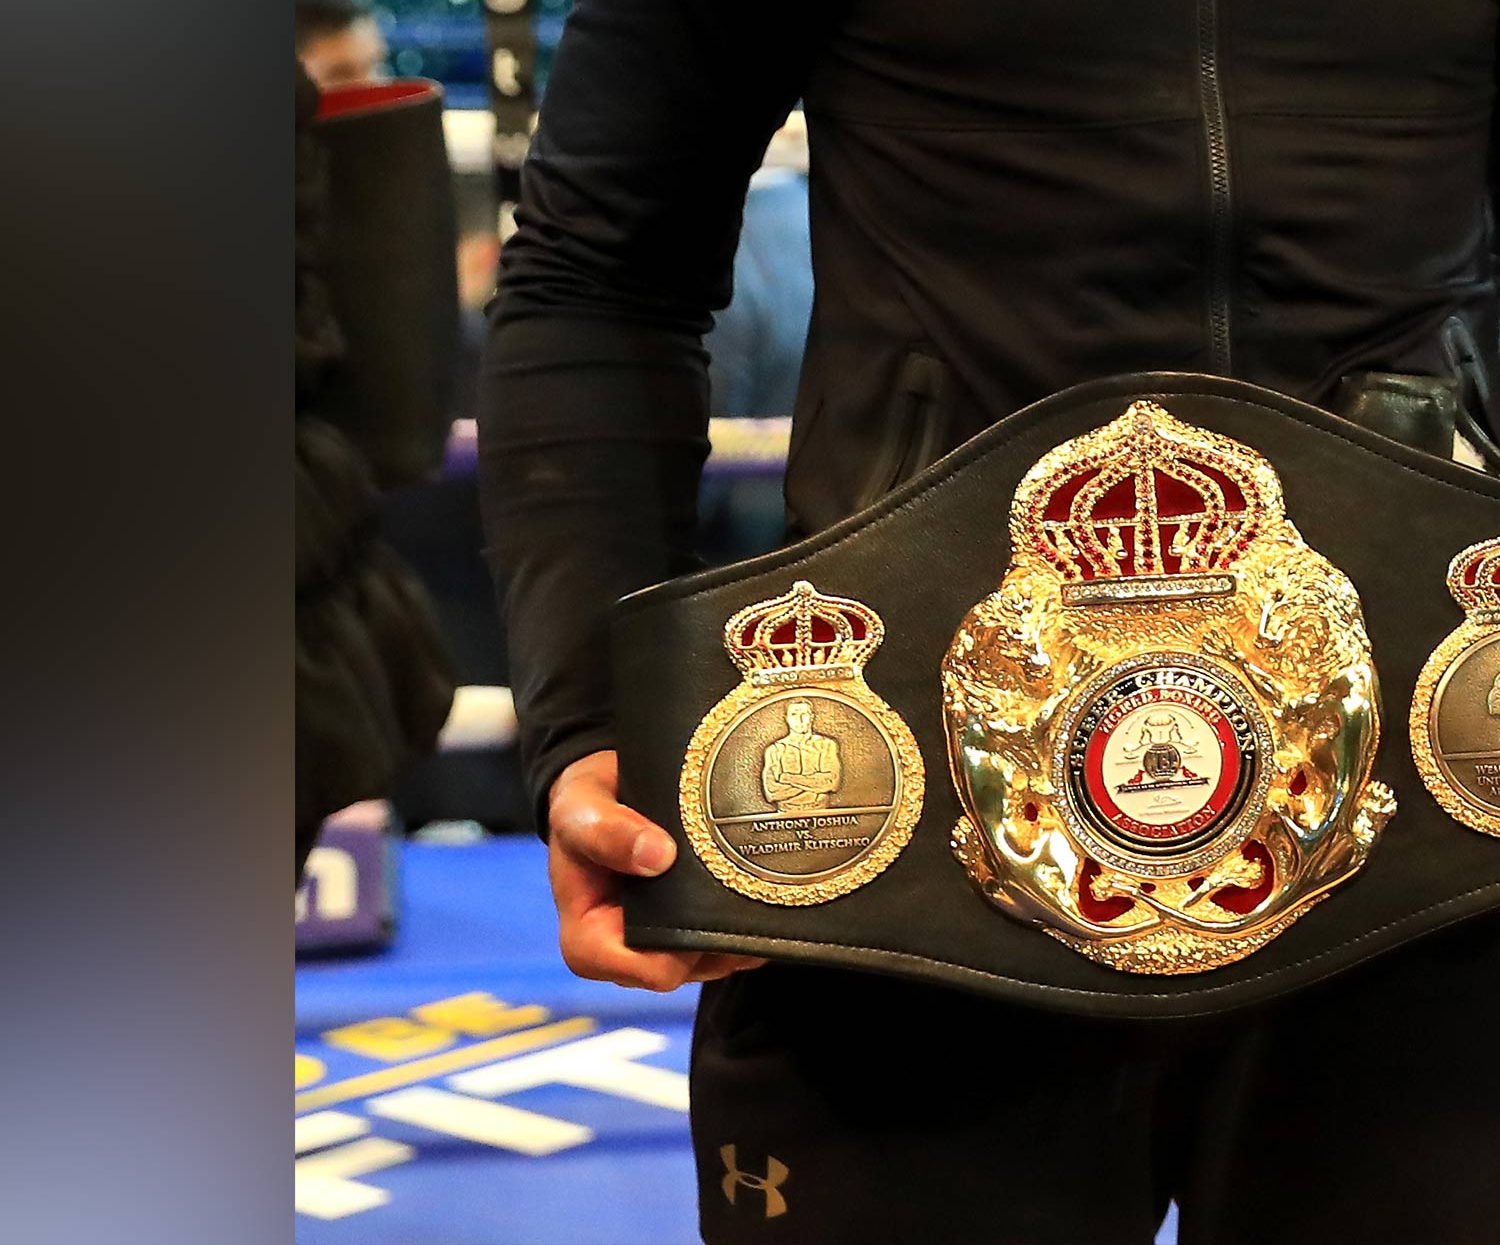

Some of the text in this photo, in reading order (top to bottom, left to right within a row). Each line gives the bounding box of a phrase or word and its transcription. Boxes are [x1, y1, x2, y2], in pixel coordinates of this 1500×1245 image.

[1134, 670, 1256, 752] CHAMPION
[752, 815, 859, 832] ANTHONY JOSHUA
[739, 837, 870, 855] WLADIMIR KLITSCHKO
